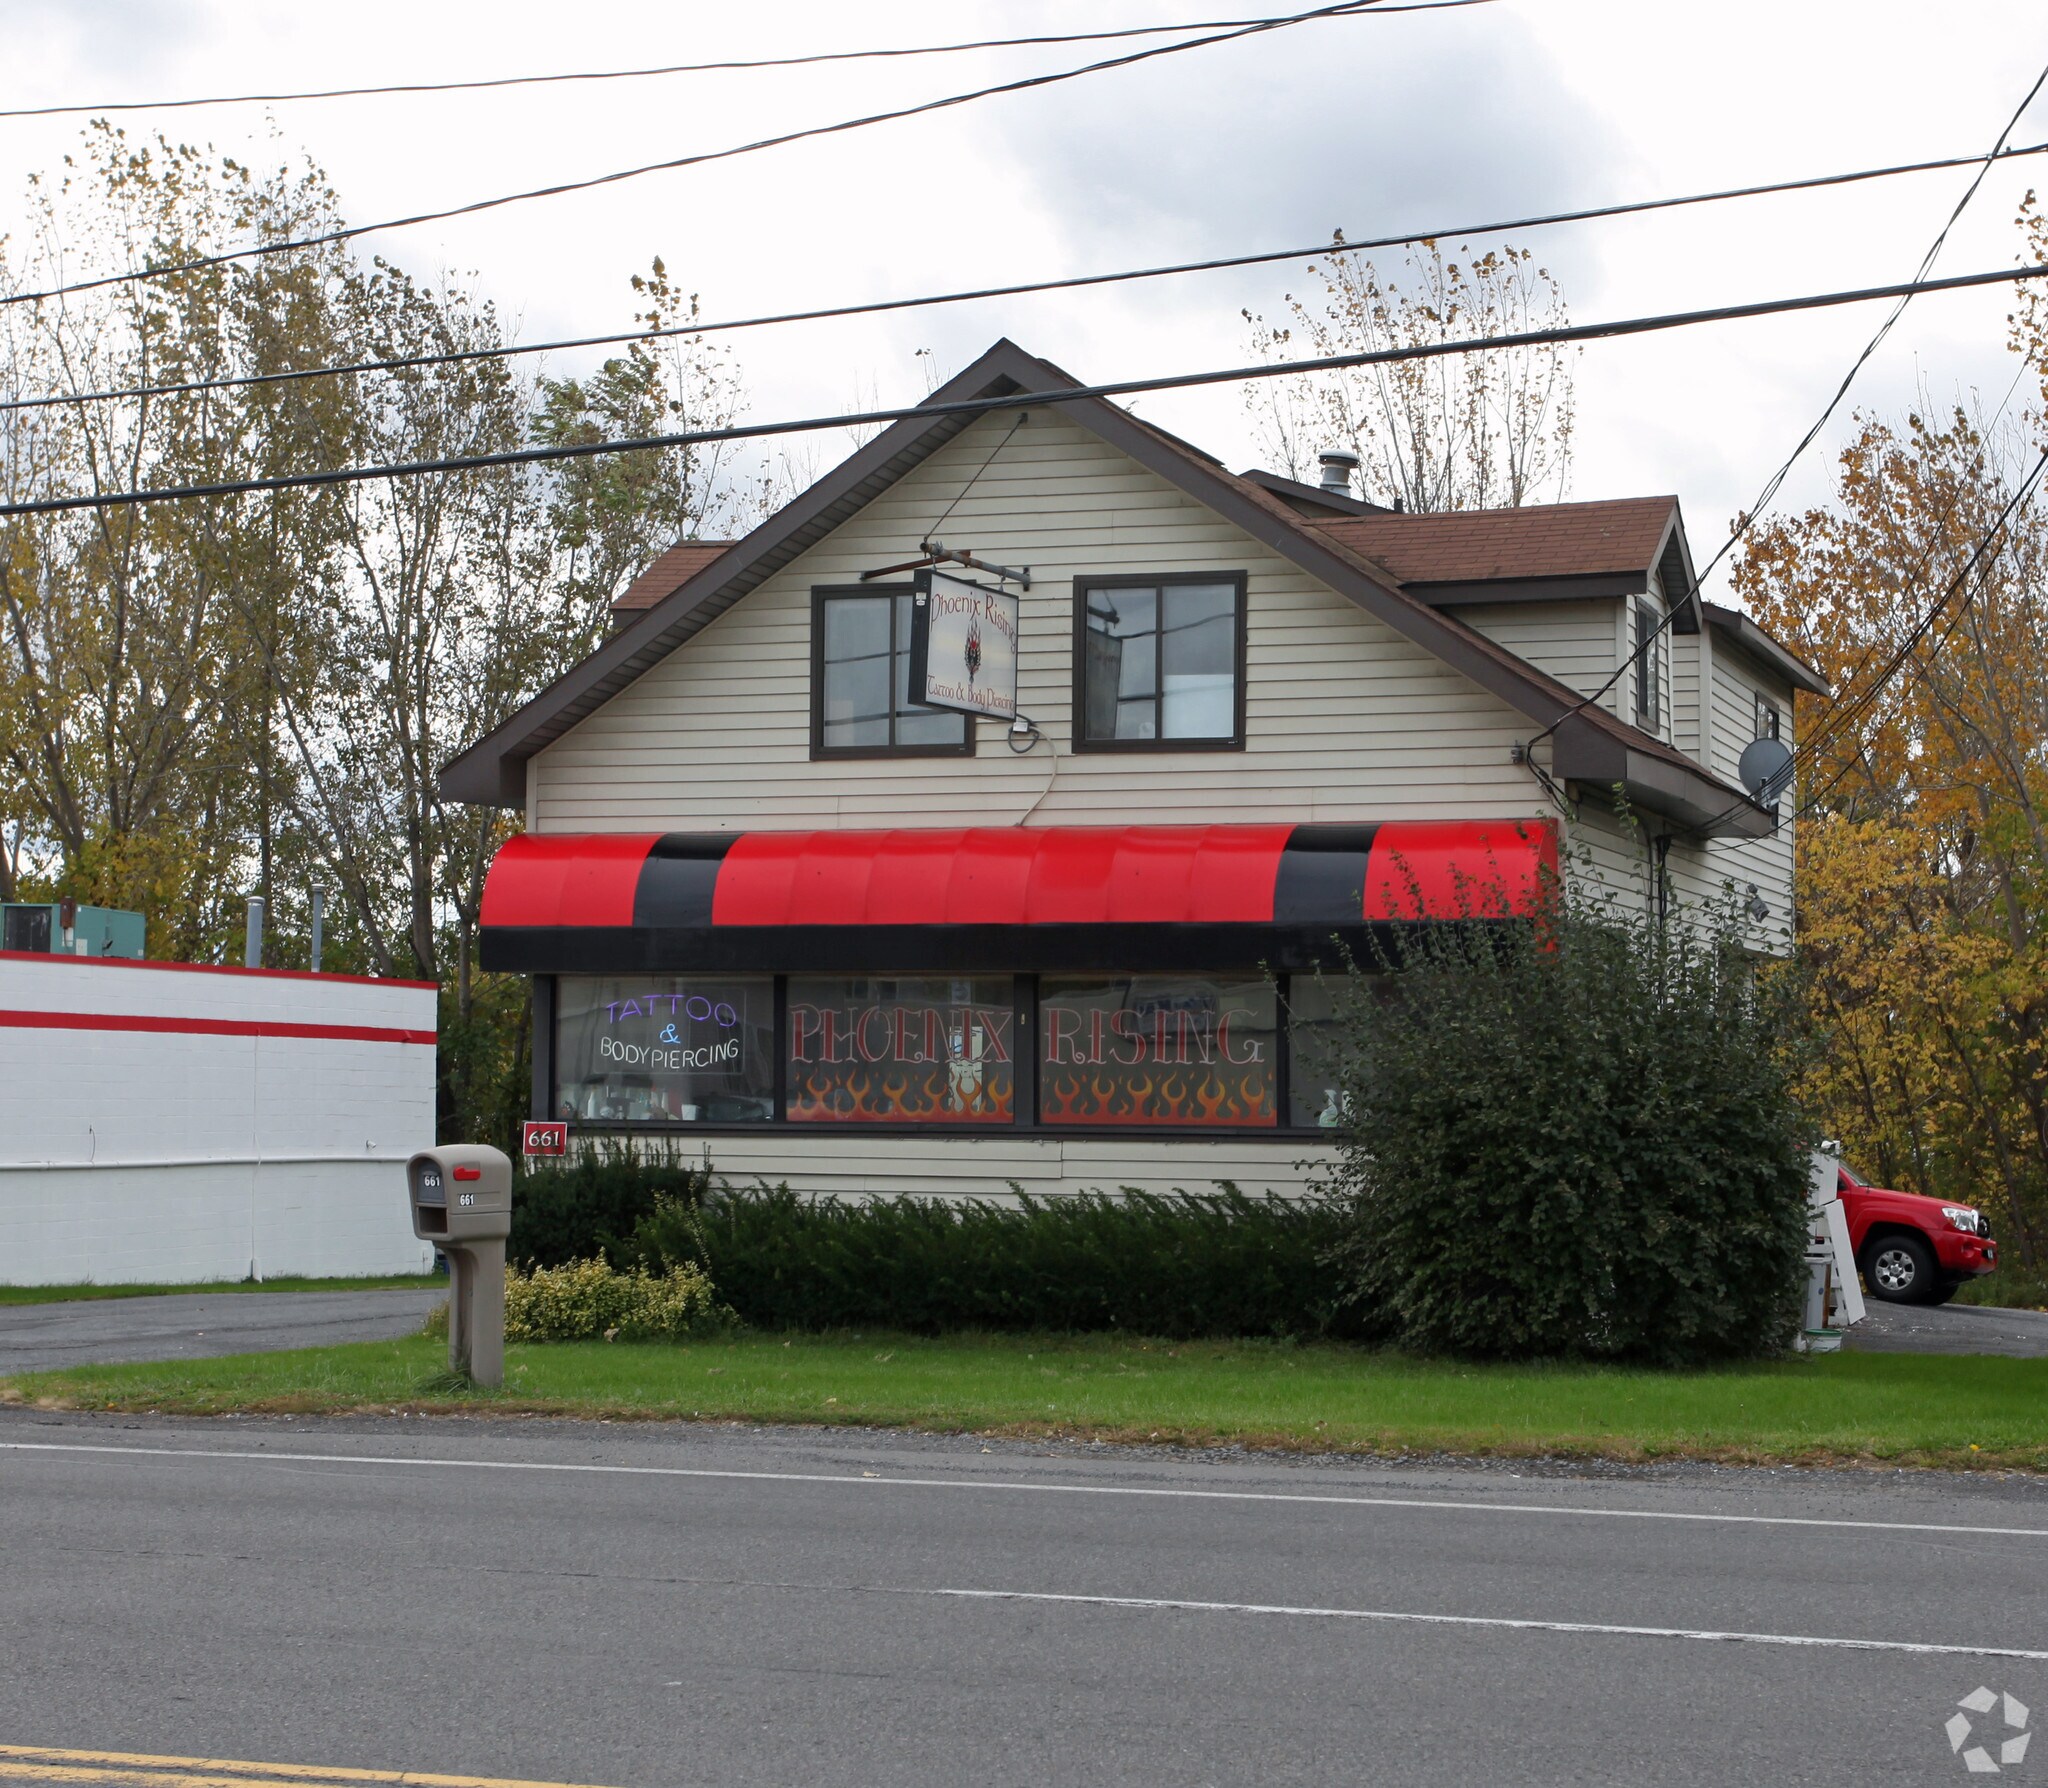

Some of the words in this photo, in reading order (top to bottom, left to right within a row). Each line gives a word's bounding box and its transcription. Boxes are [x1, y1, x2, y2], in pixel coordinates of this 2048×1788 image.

[930, 592, 981, 632] Phoenix
[985, 593, 1017, 654] Rising
[927, 674, 955, 699] Tattoo
[956, 681, 966, 702] &
[967, 684, 986, 711] Body
[606, 994, 737, 1027] TATTOO
[659, 1023, 681, 1044] &
[789, 1003, 1014, 1064] PHOENIX
[1044, 1007, 1265, 1065] RISING
[600, 1036, 651, 1065] BODY
[651, 1038, 739, 1069] PIERCING
[528, 1129, 560, 1147] 661
[424, 1175, 440, 1187] 661
[459, 1194, 474, 1206] 661
